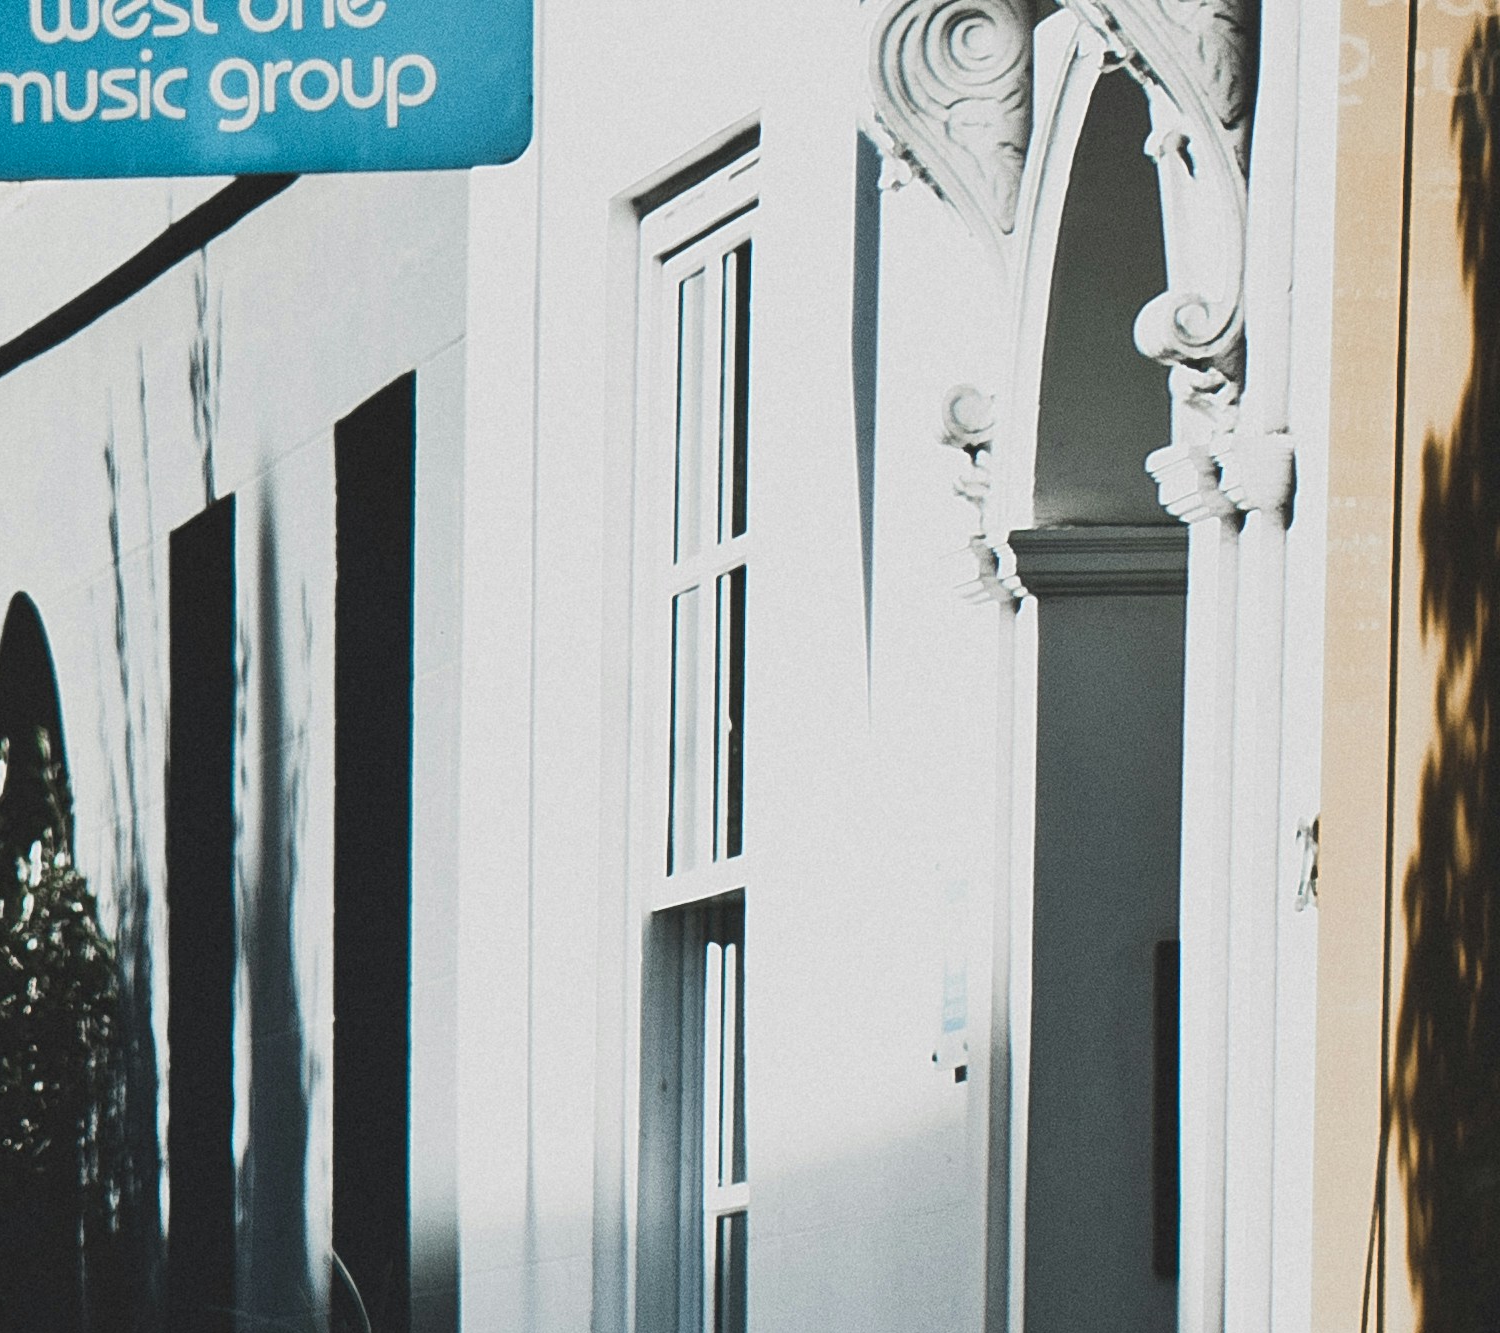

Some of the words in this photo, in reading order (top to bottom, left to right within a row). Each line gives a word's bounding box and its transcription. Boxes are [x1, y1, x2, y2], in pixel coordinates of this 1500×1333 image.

[29, 0, 219, 44] west
[238, 0, 388, 33] one
[208, 53, 438, 133] group
